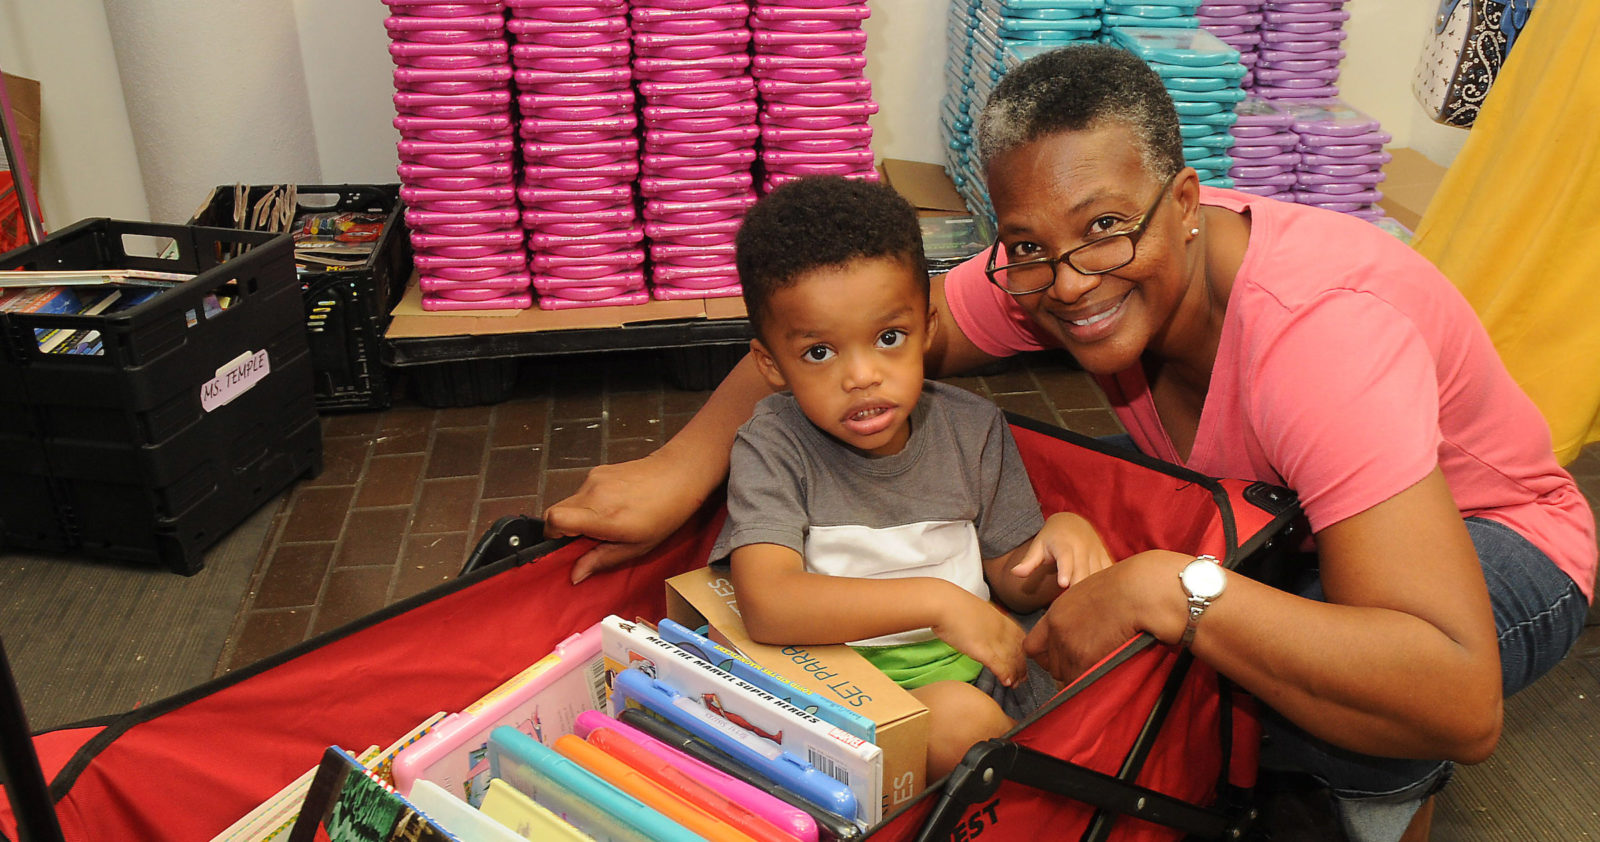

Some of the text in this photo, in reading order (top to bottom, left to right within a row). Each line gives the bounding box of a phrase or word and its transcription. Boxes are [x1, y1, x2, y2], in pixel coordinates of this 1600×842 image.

[203, 352, 265, 402] MS. TEMPLE
[646, 636, 673, 650] MEET
[673, 648, 694, 661] THE
[693, 659, 736, 682] MARVEL
[736, 681, 775, 701] SUPER
[774, 700, 820, 724] HEROES
[781, 645, 873, 707] SET PARA
